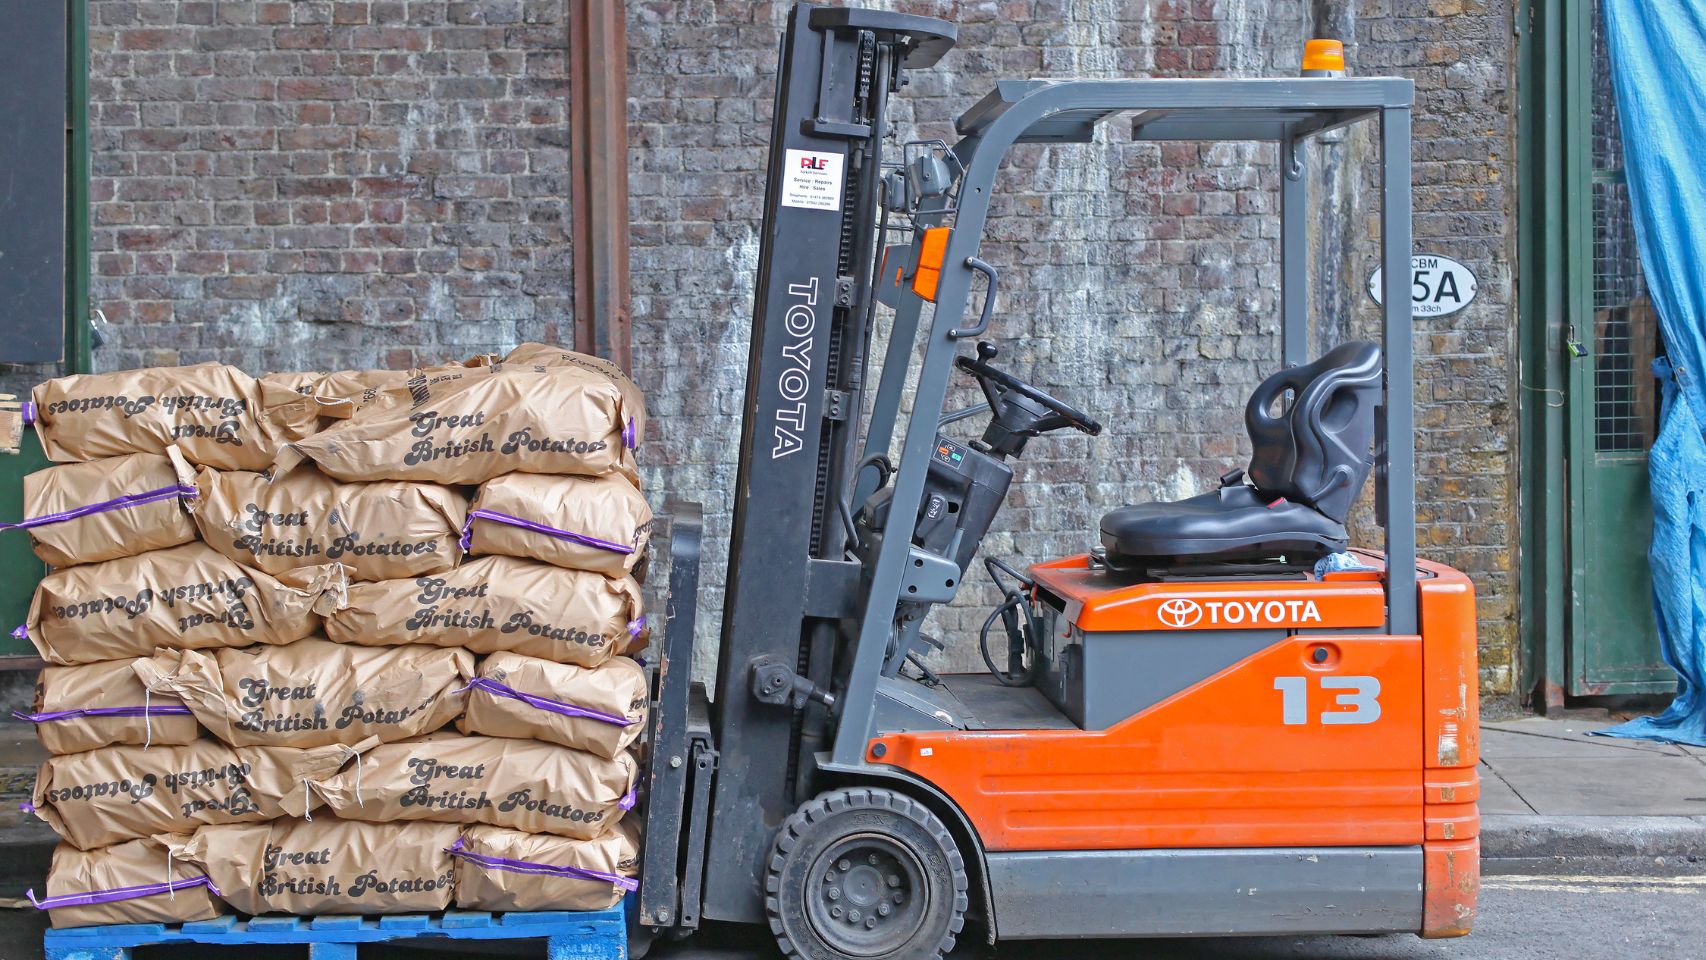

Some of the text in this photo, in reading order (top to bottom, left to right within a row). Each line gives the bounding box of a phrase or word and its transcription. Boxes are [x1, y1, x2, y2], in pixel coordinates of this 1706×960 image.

[1411, 271, 1461, 303] 5A
[1420, 305, 1442, 313] 33ch
[772, 277, 819, 459] TOYOTA
[48, 395, 247, 419] British Potatoes
[171, 421, 243, 446] Great
[409, 409, 485, 437] Great
[404, 433, 495, 466] British
[233, 531, 438, 563] British Potatoes
[52, 576, 254, 620] British Potatoe
[416, 577, 489, 605] Great
[179, 602, 255, 633] Great
[406, 605, 607, 647] British Potatoes
[1205, 600, 1322, 624] TOYOTA
[239, 677, 316, 707] Great
[1273, 676, 1382, 725] 13
[234, 707, 328, 733] British
[49, 762, 251, 805] British Potatoes
[408, 757, 485, 785] Great
[181, 787, 263, 818] Great
[400, 783, 605, 824] British Potatoes
[263, 843, 331, 873] Great
[257, 872, 341, 898] British
